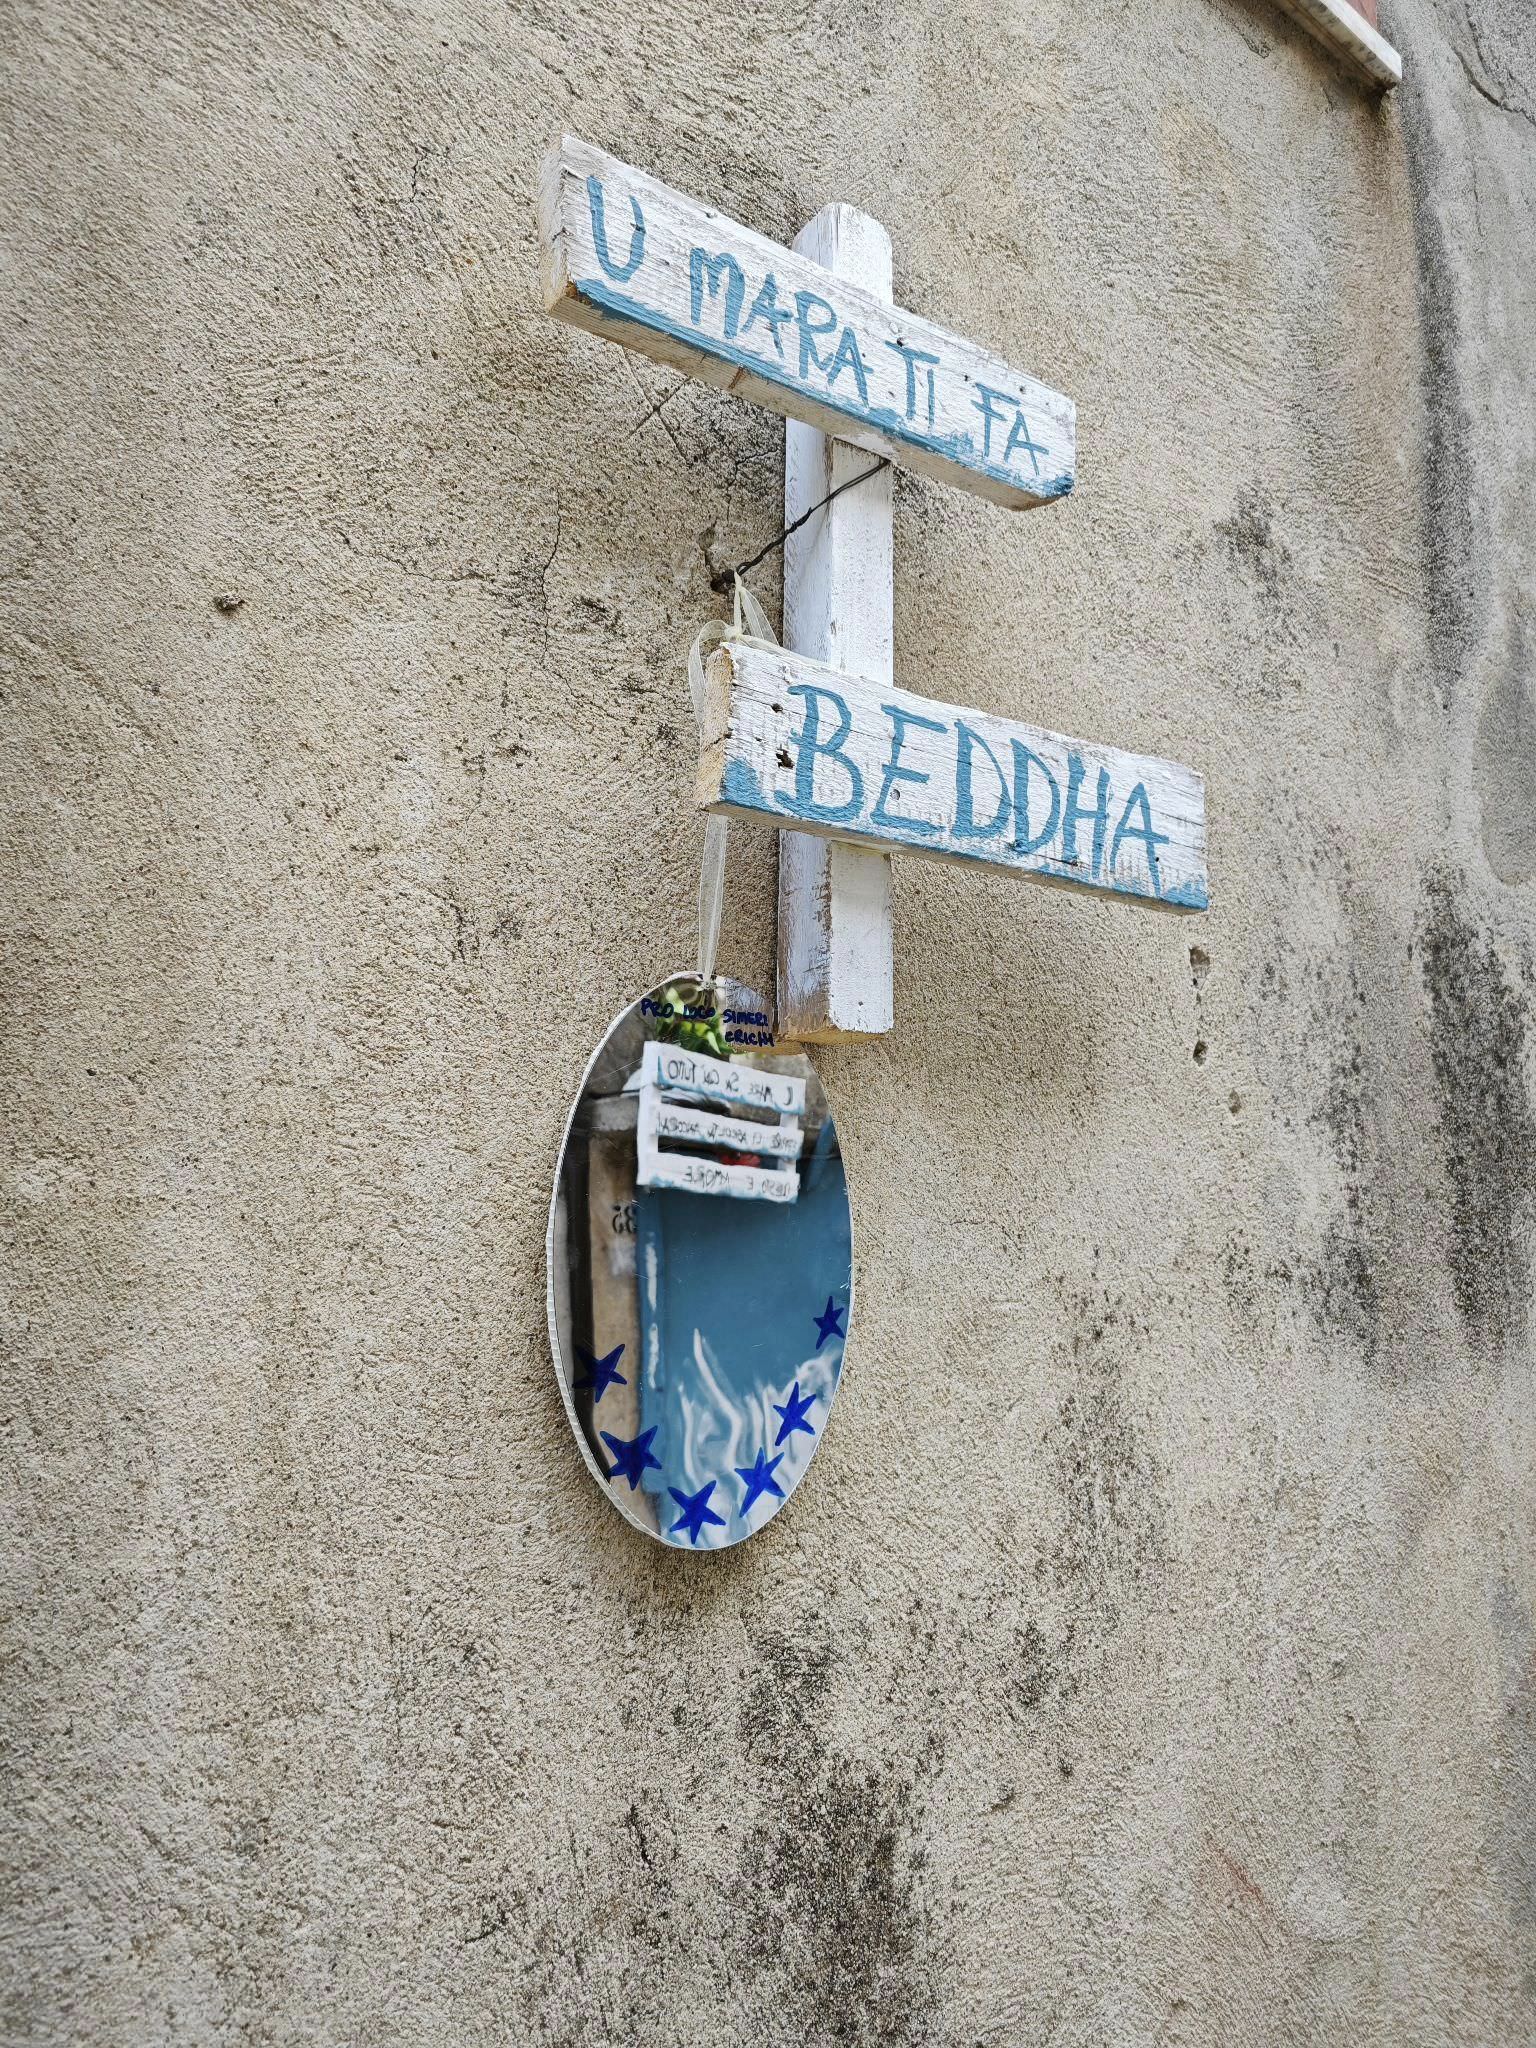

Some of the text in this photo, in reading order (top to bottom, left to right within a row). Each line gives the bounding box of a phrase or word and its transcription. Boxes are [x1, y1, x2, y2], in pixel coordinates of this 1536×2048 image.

[586, 174, 646, 284] U
[774, 684, 1170, 899] BEDDHA
[640, 997, 675, 1019] PRO
[683, 1004, 717, 1020] LOCO
